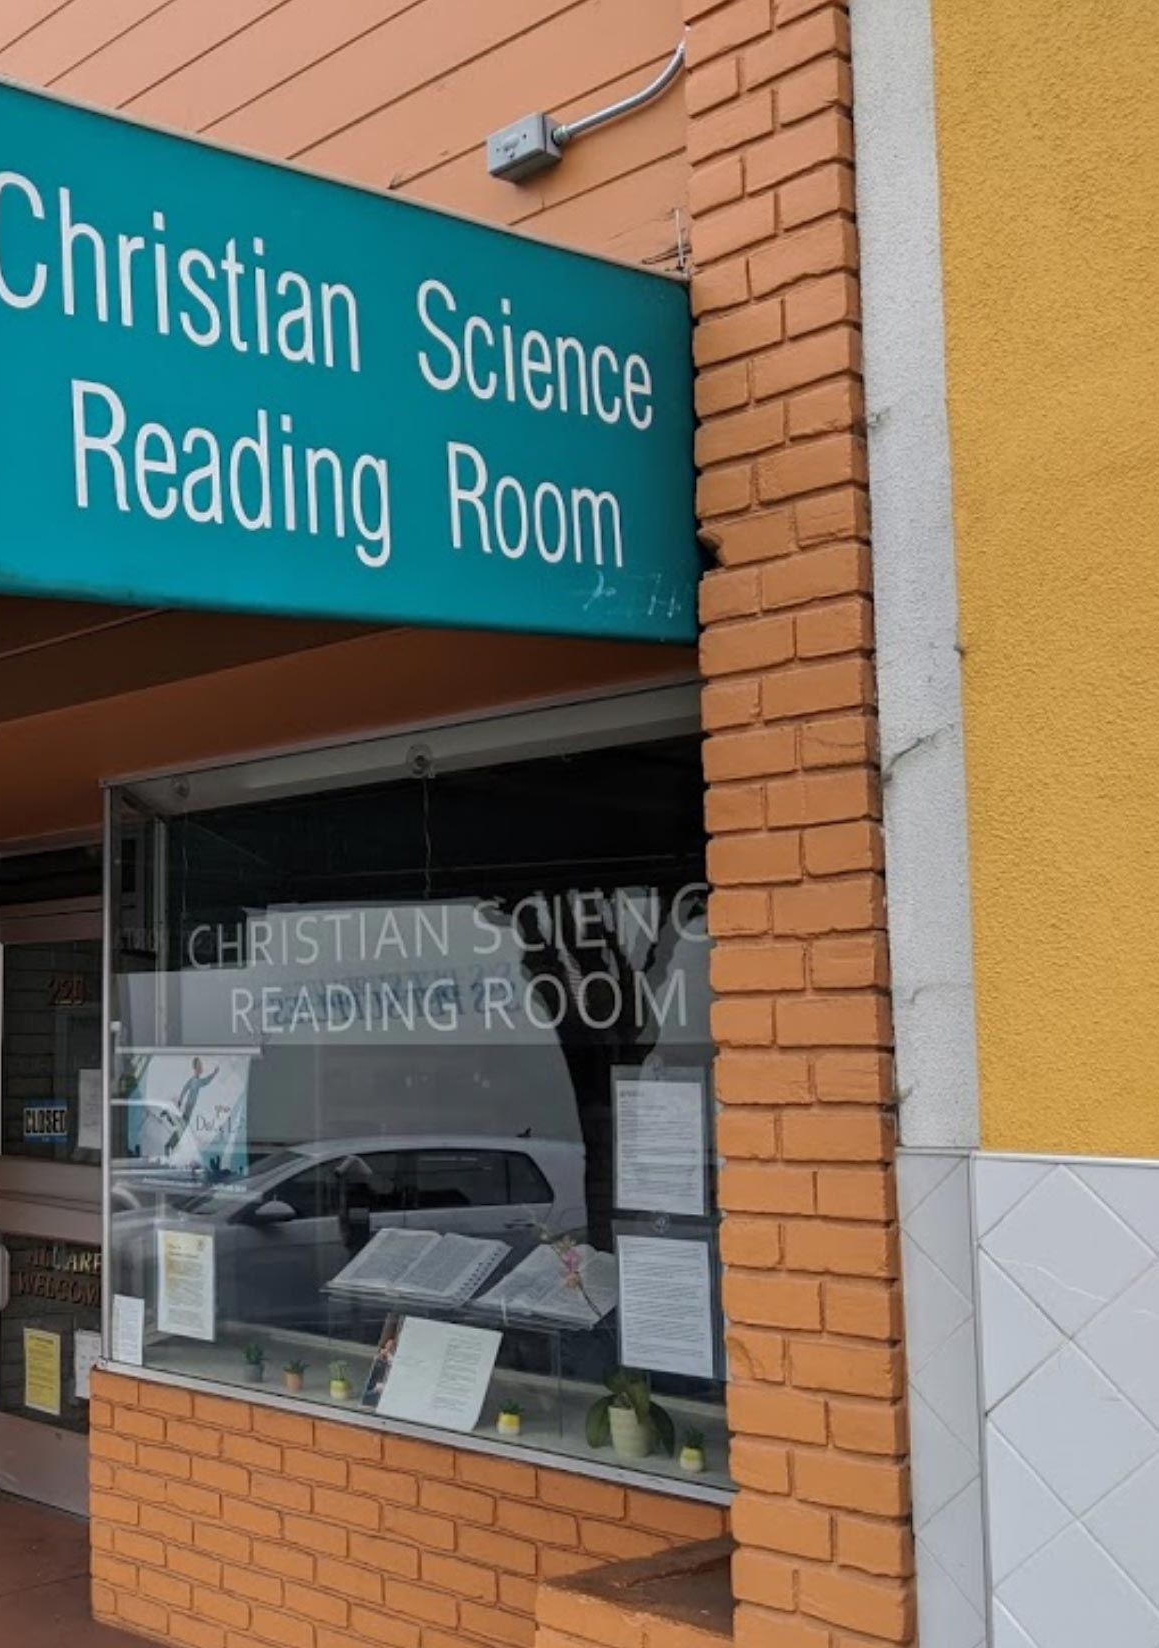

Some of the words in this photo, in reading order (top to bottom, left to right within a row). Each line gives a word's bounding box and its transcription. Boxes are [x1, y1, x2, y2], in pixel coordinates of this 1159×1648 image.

[417, 280, 653, 430] Science
[71, 379, 390, 567] Reading
[447, 441, 623, 567] Room
[188, 906, 449, 971] CHRISTIAN
[472, 883, 709, 956] SCIENC
[231, 976, 457, 1034] READING
[484, 969, 687, 1031] ROOM
[25, 1109, 66, 1133] CLOSED
